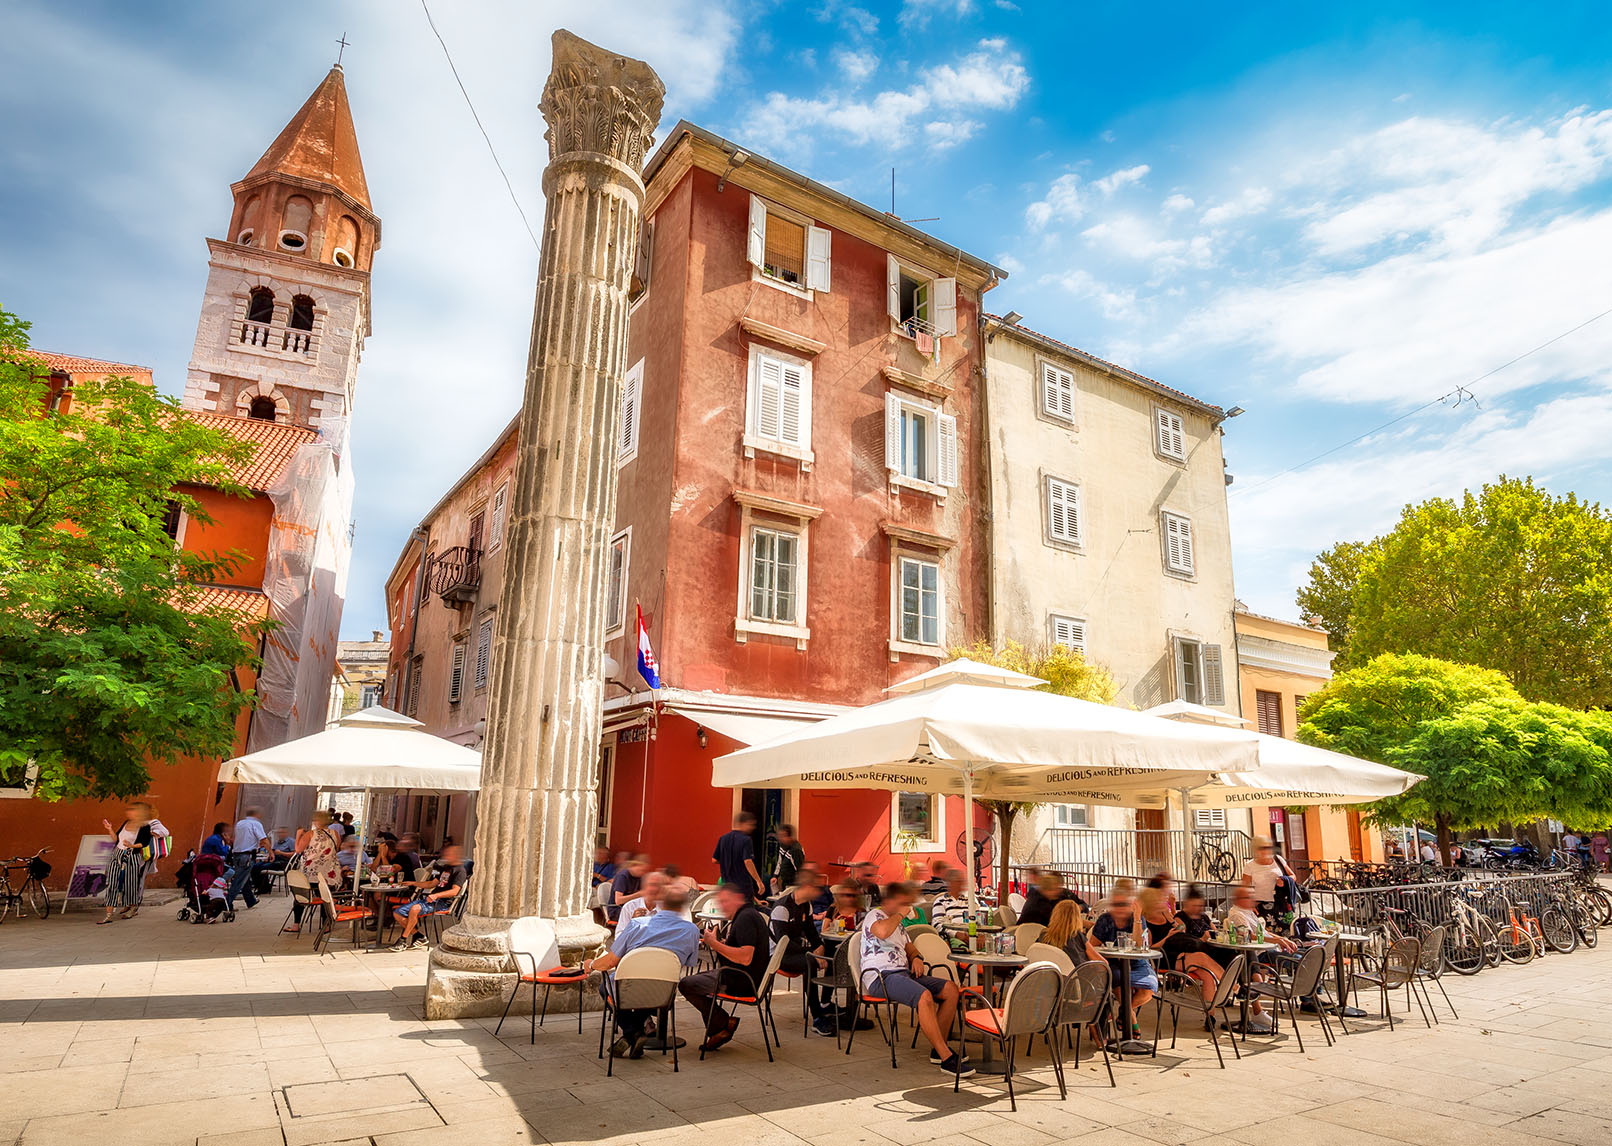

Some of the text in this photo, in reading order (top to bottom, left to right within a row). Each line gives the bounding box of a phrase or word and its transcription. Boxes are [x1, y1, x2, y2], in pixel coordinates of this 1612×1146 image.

[800, 772, 854, 782] DELICIOUS
[869, 771, 928, 786] REFRESHING
[1047, 769, 1093, 783] DELICIOUS
[1078, 790, 1122, 802] REFRESHING
[1225, 791, 1273, 803] DELICIOUS
